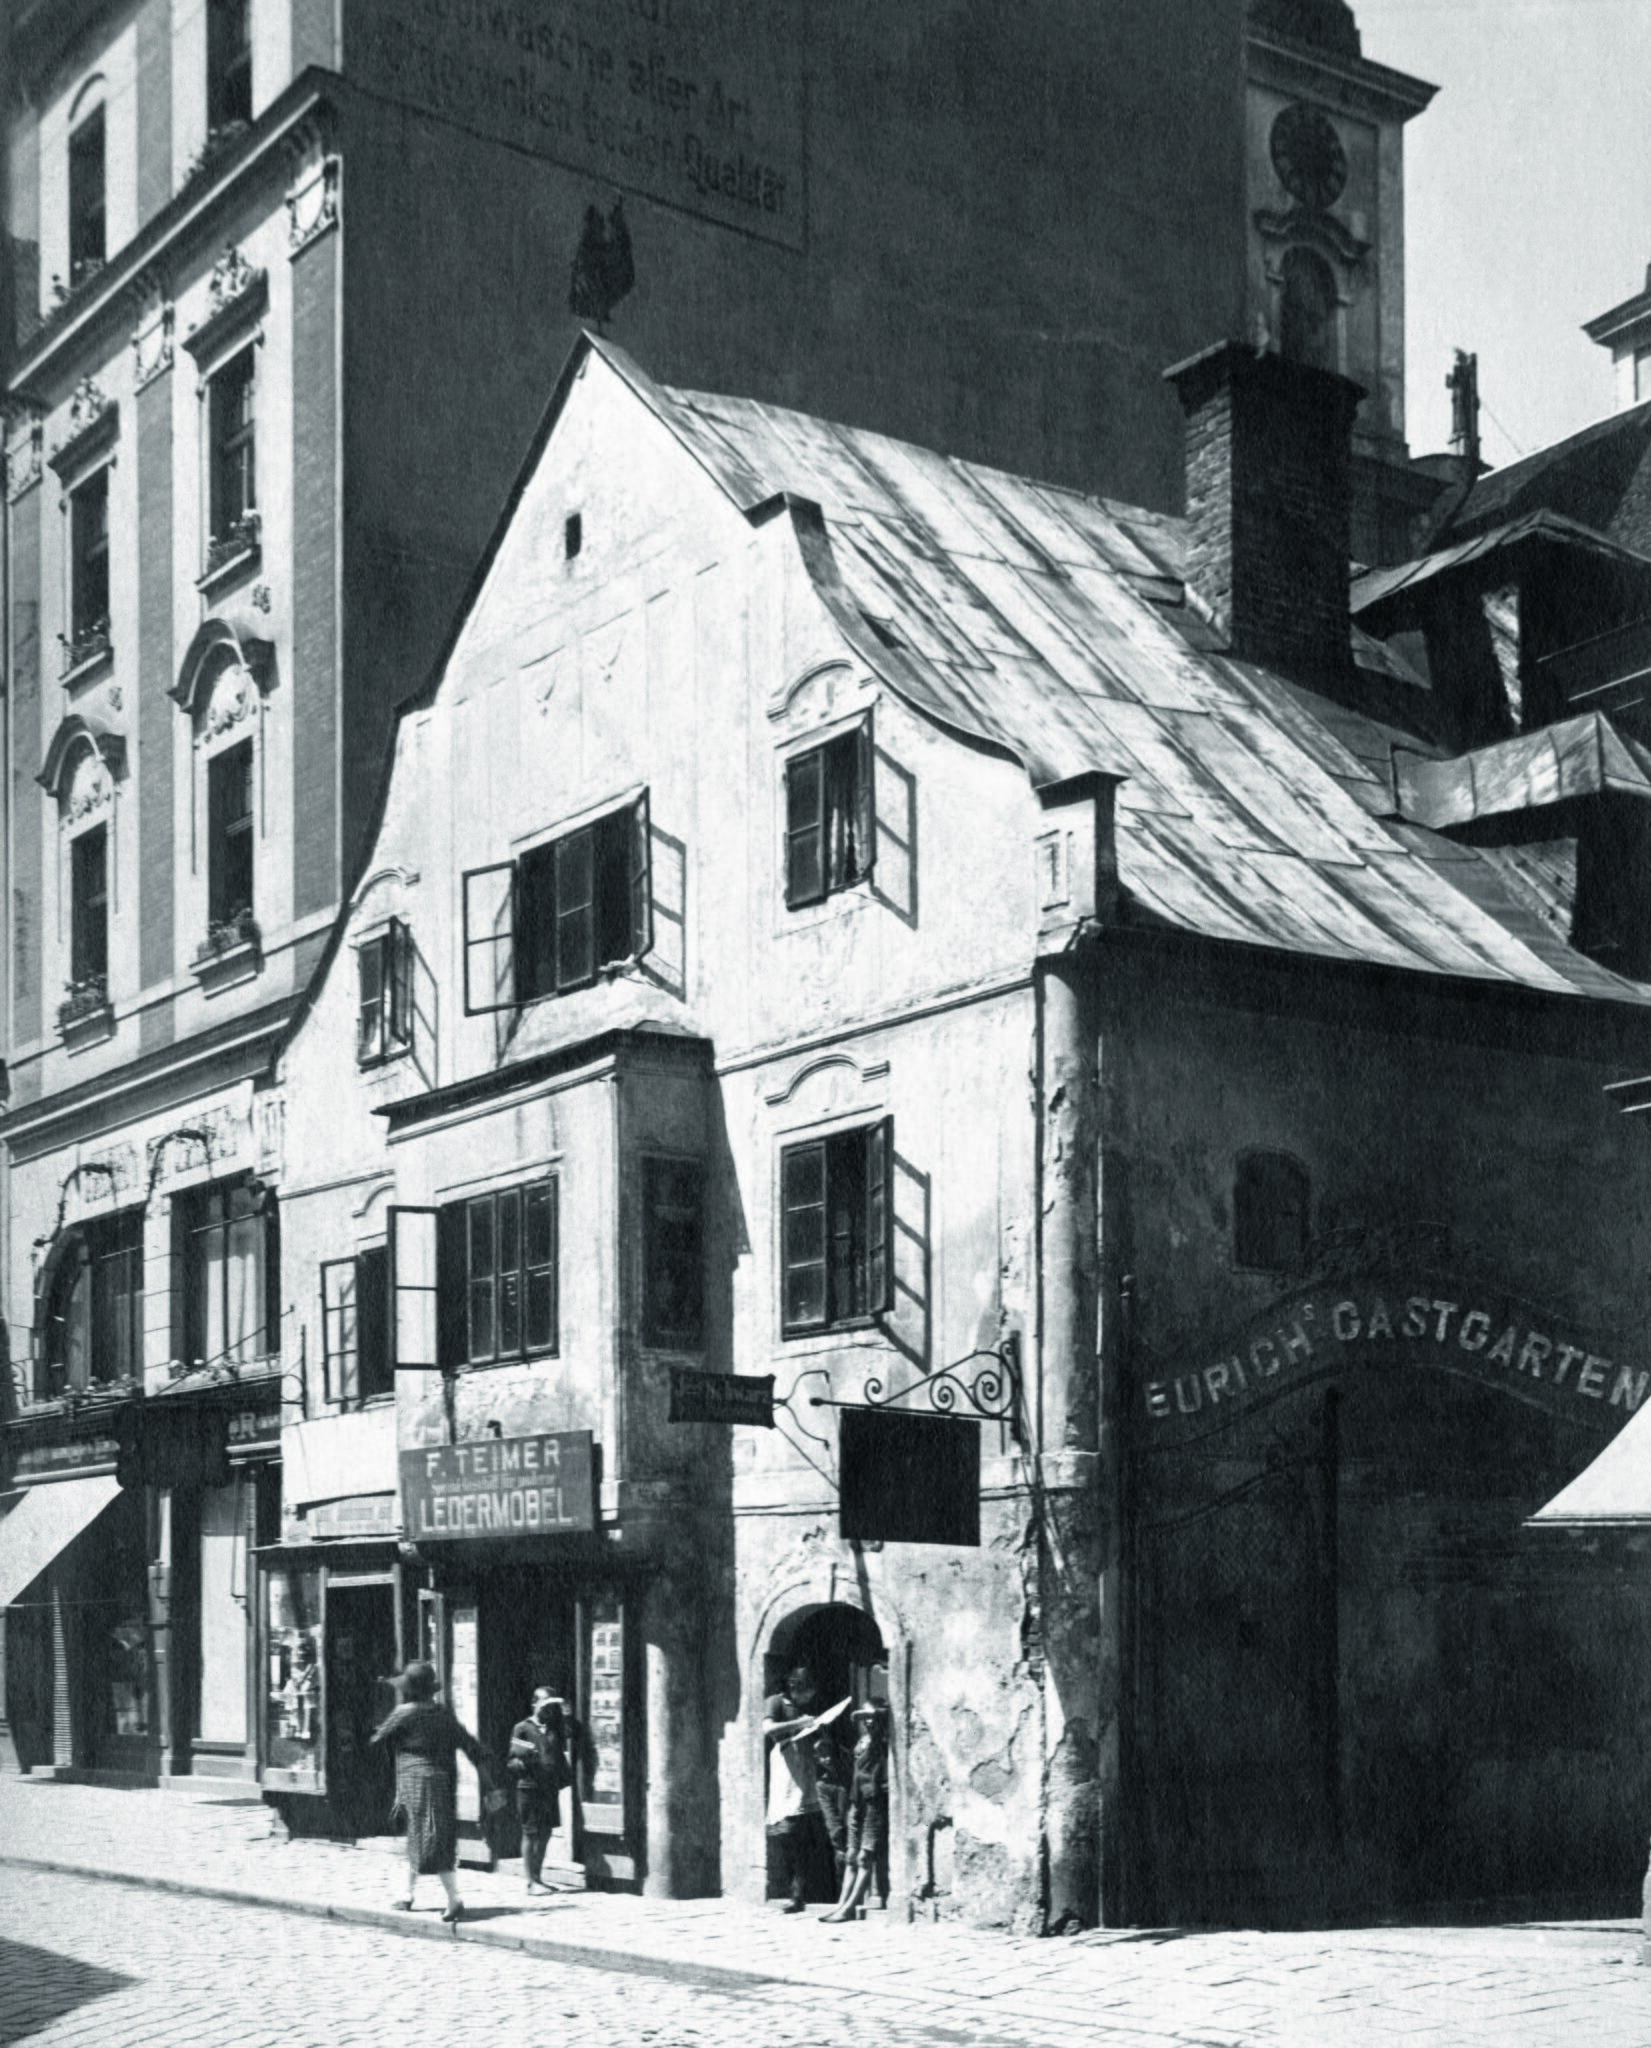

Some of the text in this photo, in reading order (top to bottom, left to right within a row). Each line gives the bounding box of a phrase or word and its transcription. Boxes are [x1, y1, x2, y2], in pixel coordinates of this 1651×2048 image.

[1332, 1297, 1651, 1411] GASTGARTEN
[426, 1438, 561, 1478] F. TEIMER
